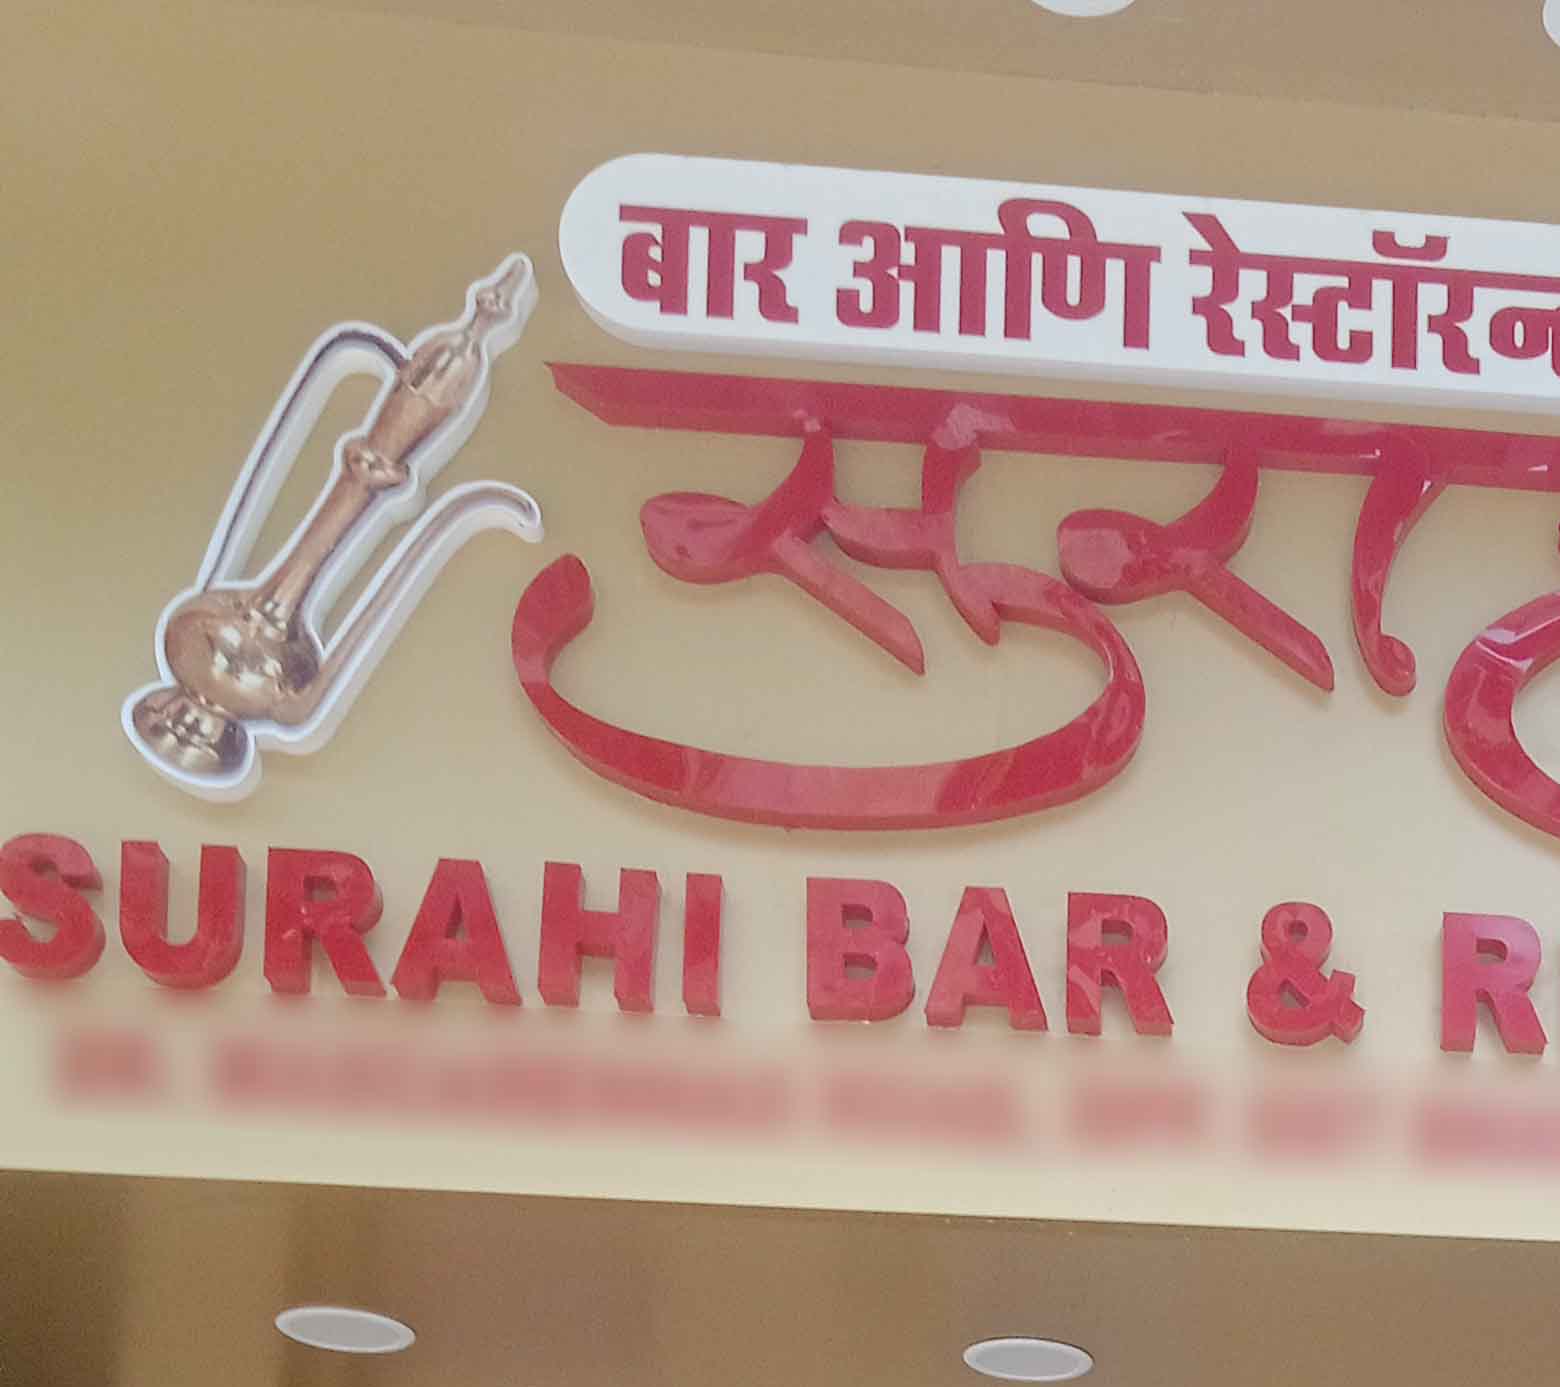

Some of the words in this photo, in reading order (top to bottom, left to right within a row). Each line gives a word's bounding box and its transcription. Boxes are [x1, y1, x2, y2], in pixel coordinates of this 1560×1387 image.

[618, 204, 808, 323] बार
[836, 199, 1162, 350] आणि
[0, 832, 723, 1019] SURAHI
[806, 877, 1175, 1036] BAR
[1246, 901, 1366, 1047] &
